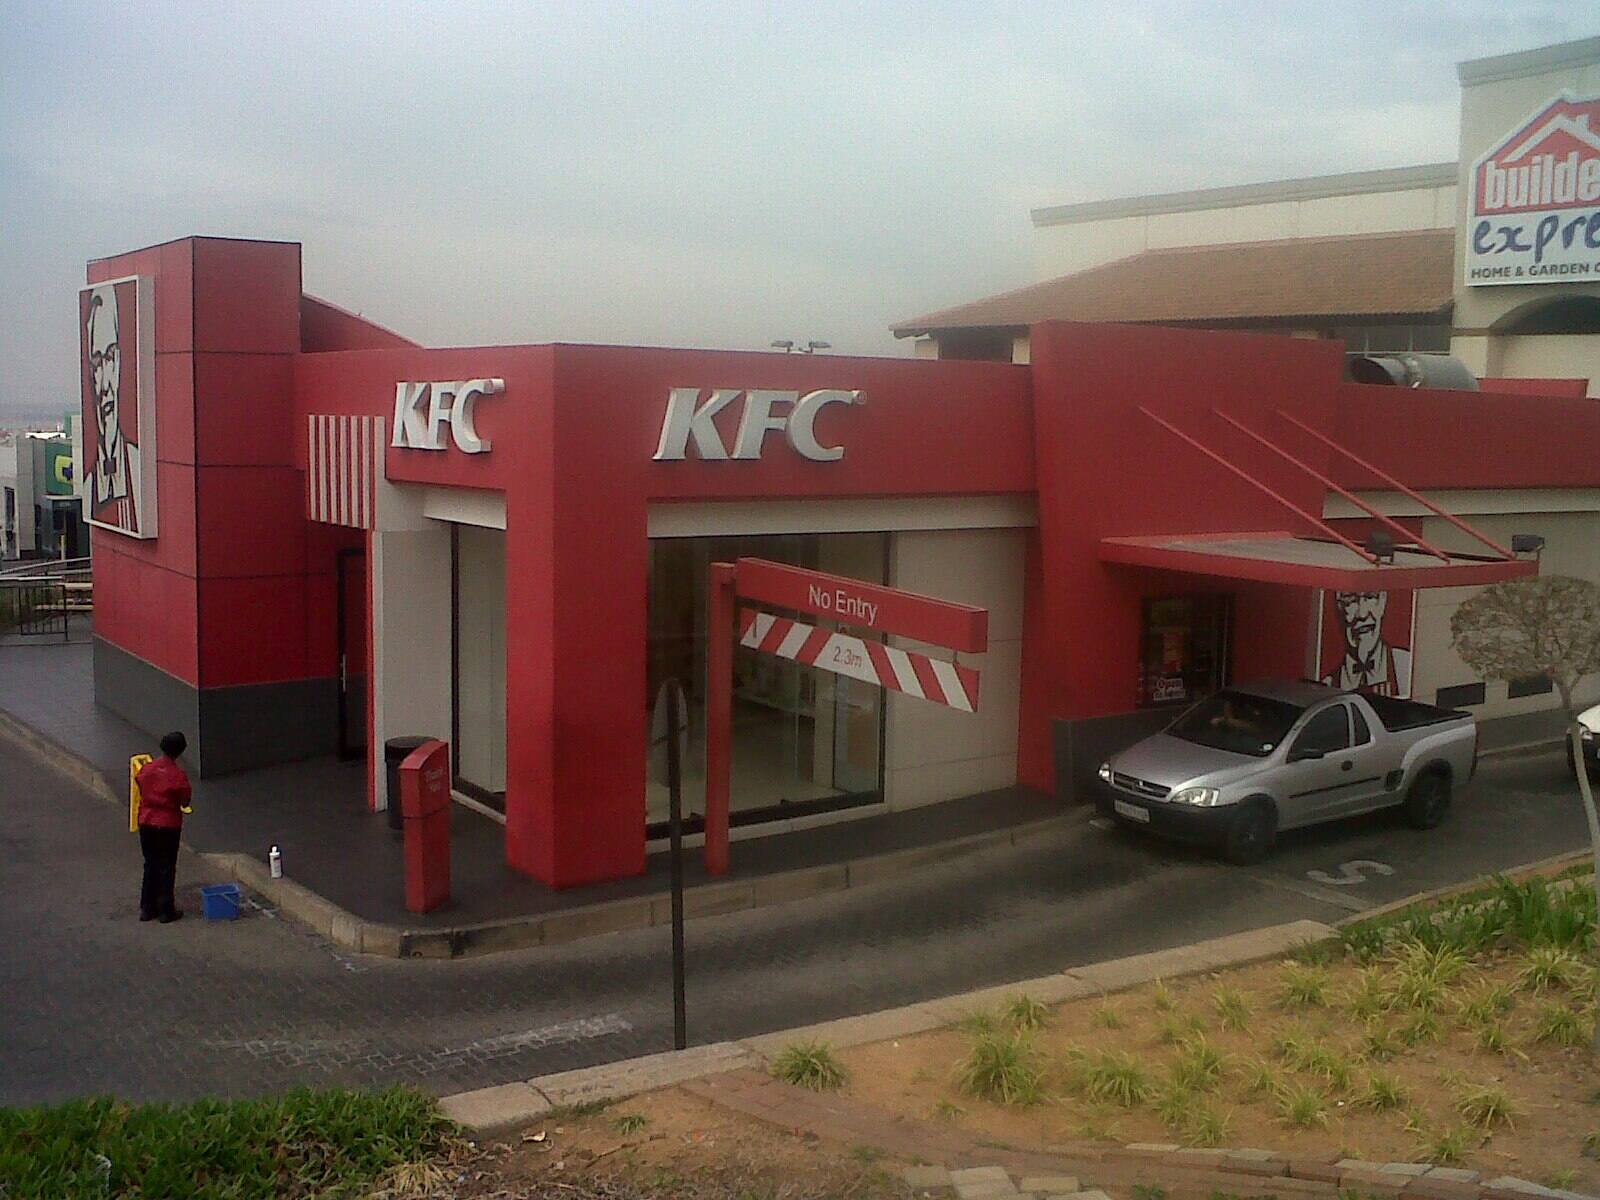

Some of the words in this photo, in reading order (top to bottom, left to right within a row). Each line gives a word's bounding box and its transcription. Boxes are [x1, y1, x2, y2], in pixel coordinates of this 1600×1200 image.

[1485, 150, 1600, 209] builde
[1471, 266, 1511, 279] HOME
[1515, 265, 1523, 277] &
[1528, 263, 1590, 277] GARDEN
[390, 378, 505, 454] KFC
[652, 388, 862, 462] KFC
[808, 583, 831, 609] No
[835, 589, 879, 627] Entry
[832, 645, 864, 669] 2.3m
